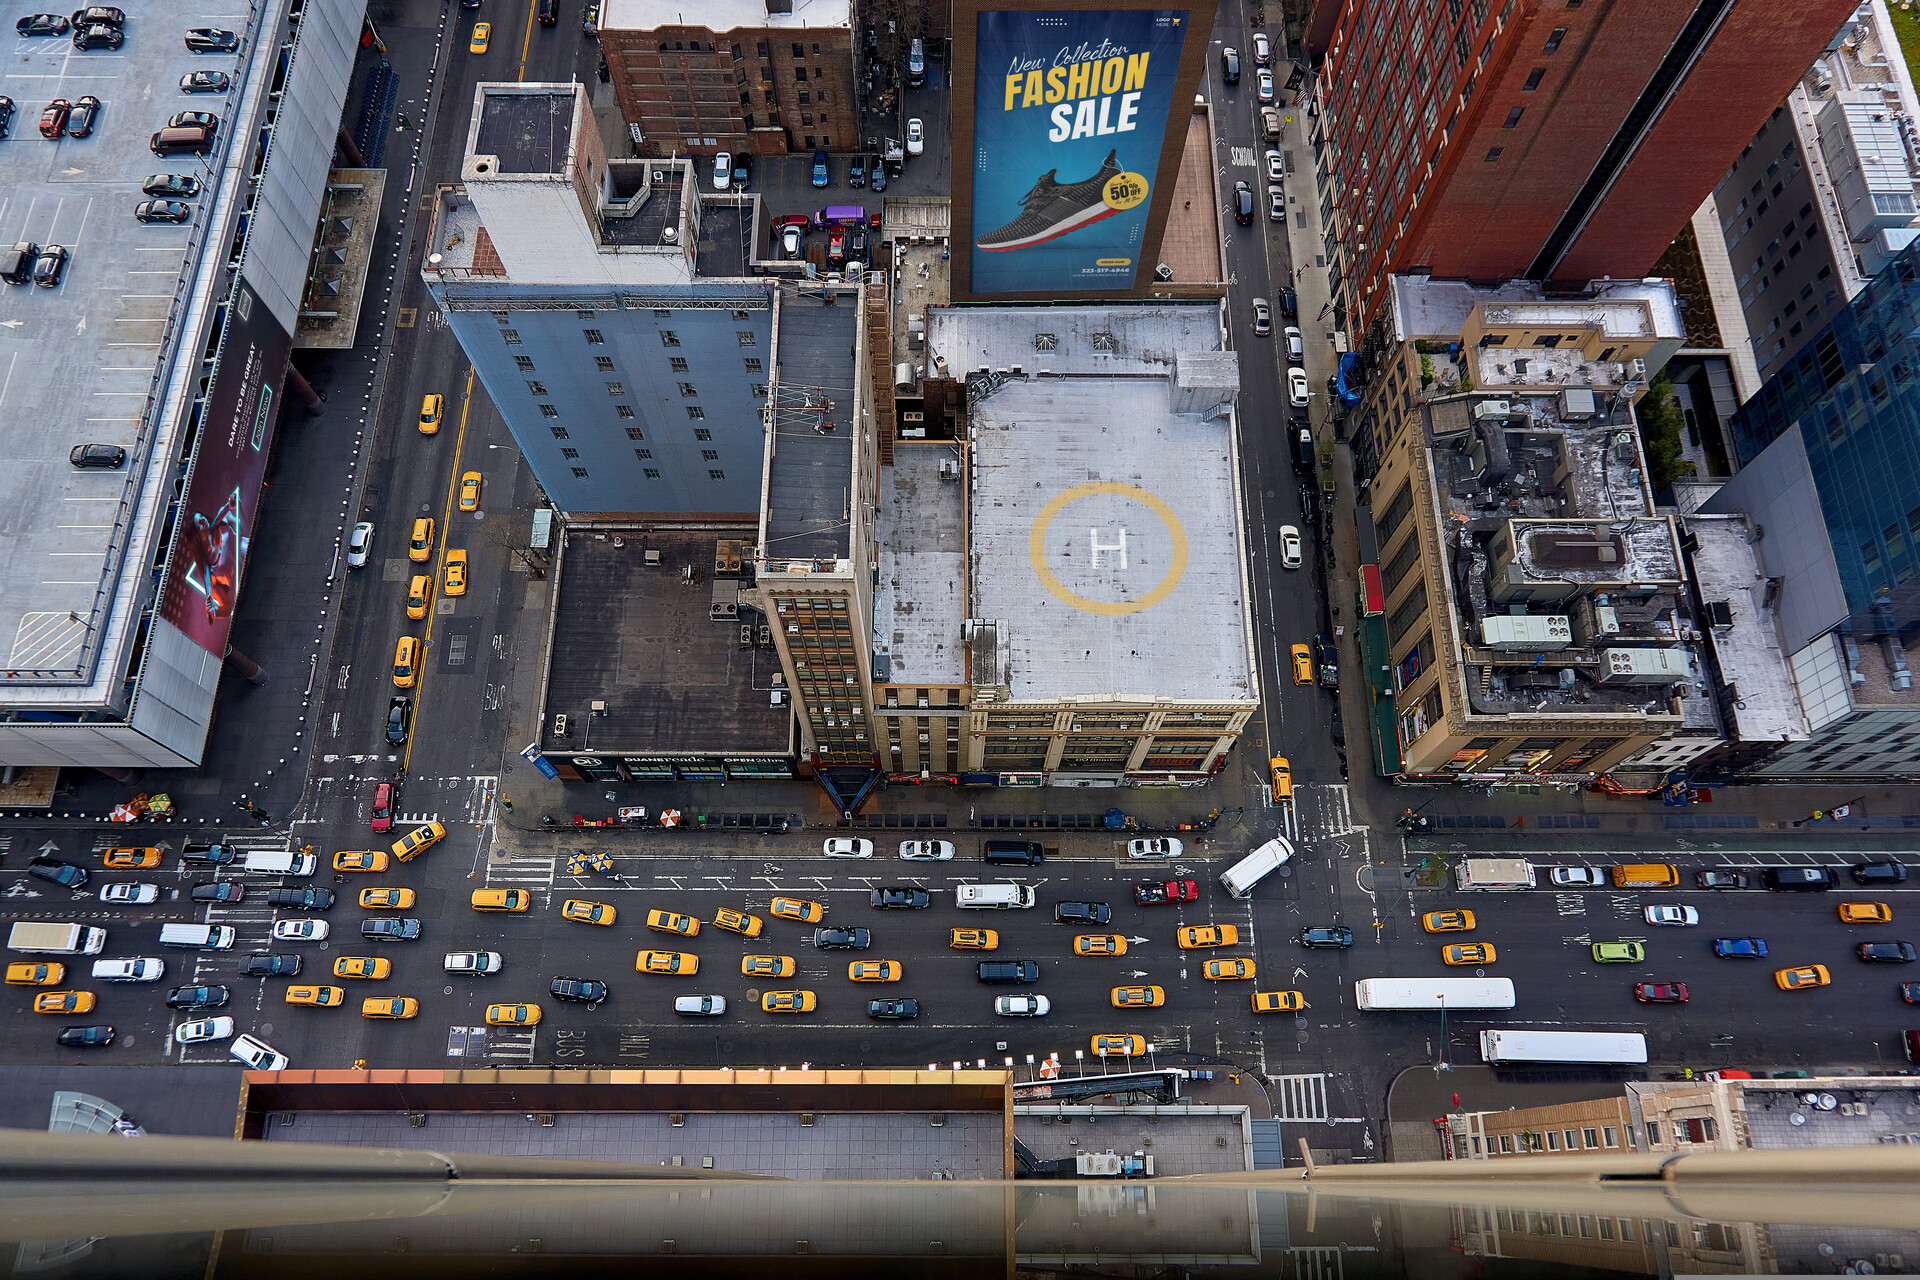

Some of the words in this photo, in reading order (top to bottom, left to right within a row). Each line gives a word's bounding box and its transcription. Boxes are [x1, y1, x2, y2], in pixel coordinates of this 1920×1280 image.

[1006, 51, 1046, 76] New
[1052, 38, 1129, 68] Collection
[1004, 51, 1150, 111] FASHION
[1049, 91, 1142, 143] SALE
[1230, 146, 1257, 166] SCHOOL
[1130, 188, 1141, 196] OFF
[228, 413, 238, 447] DARE
[235, 398, 243, 413] TO
[239, 381, 247, 397] BE
[244, 342, 256, 379] GREAT
[255, 420, 263, 442] Join
[260, 393, 269, 418] Now
[1091, 528, 1127, 569] H
[484, 683, 506, 711] BUS
[1149, 757, 1196, 766] SILENCE!
[556, 1030, 586, 1057] BUS
[619, 1032, 650, 1059] ONLY
